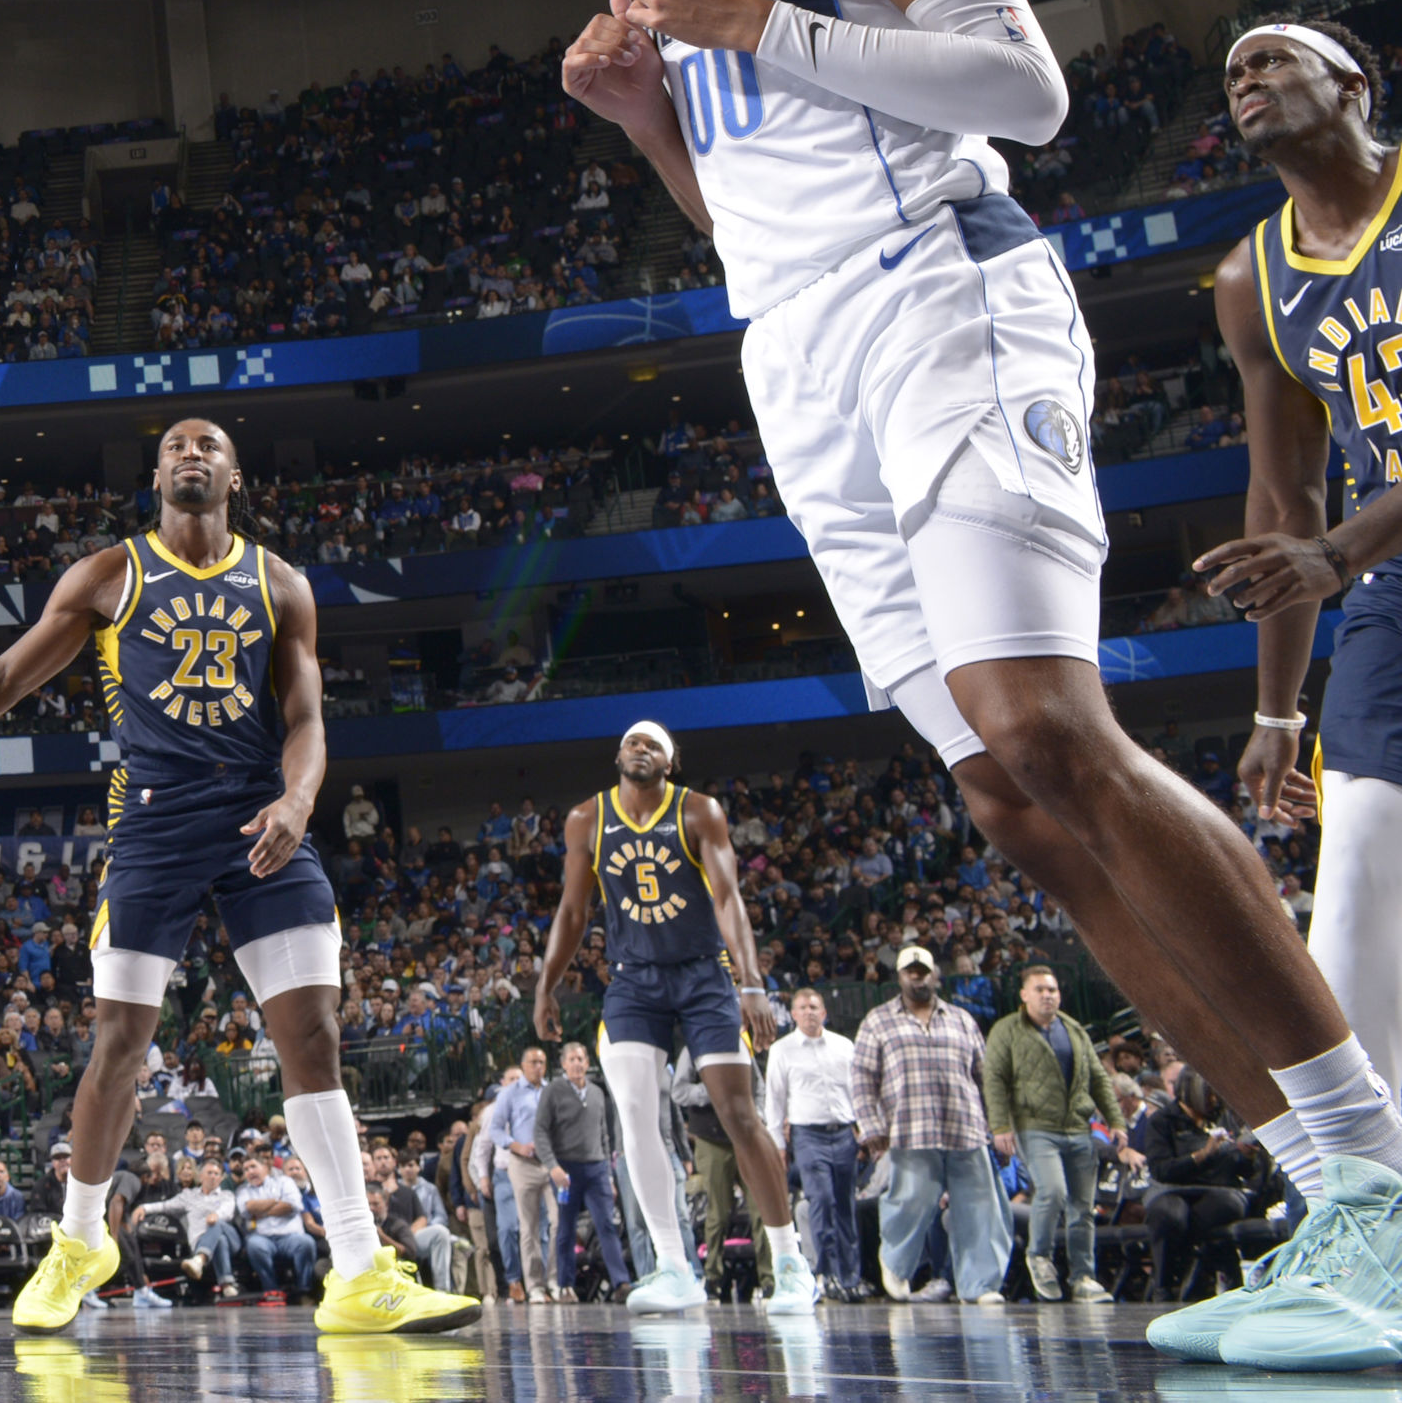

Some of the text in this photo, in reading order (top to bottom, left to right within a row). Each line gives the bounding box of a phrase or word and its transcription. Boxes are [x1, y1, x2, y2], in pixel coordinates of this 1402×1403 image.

[680, 49, 764, 157] 00
[224, 574, 247, 584] LUCAS
[141, 593, 263, 648] INDIANA
[172, 629, 237, 688] 23
[149, 680, 254, 726] PACERS
[606, 839, 681, 876] INDIANA
[636, 862, 660, 901] 5
[620, 893, 687, 924] PACERS
